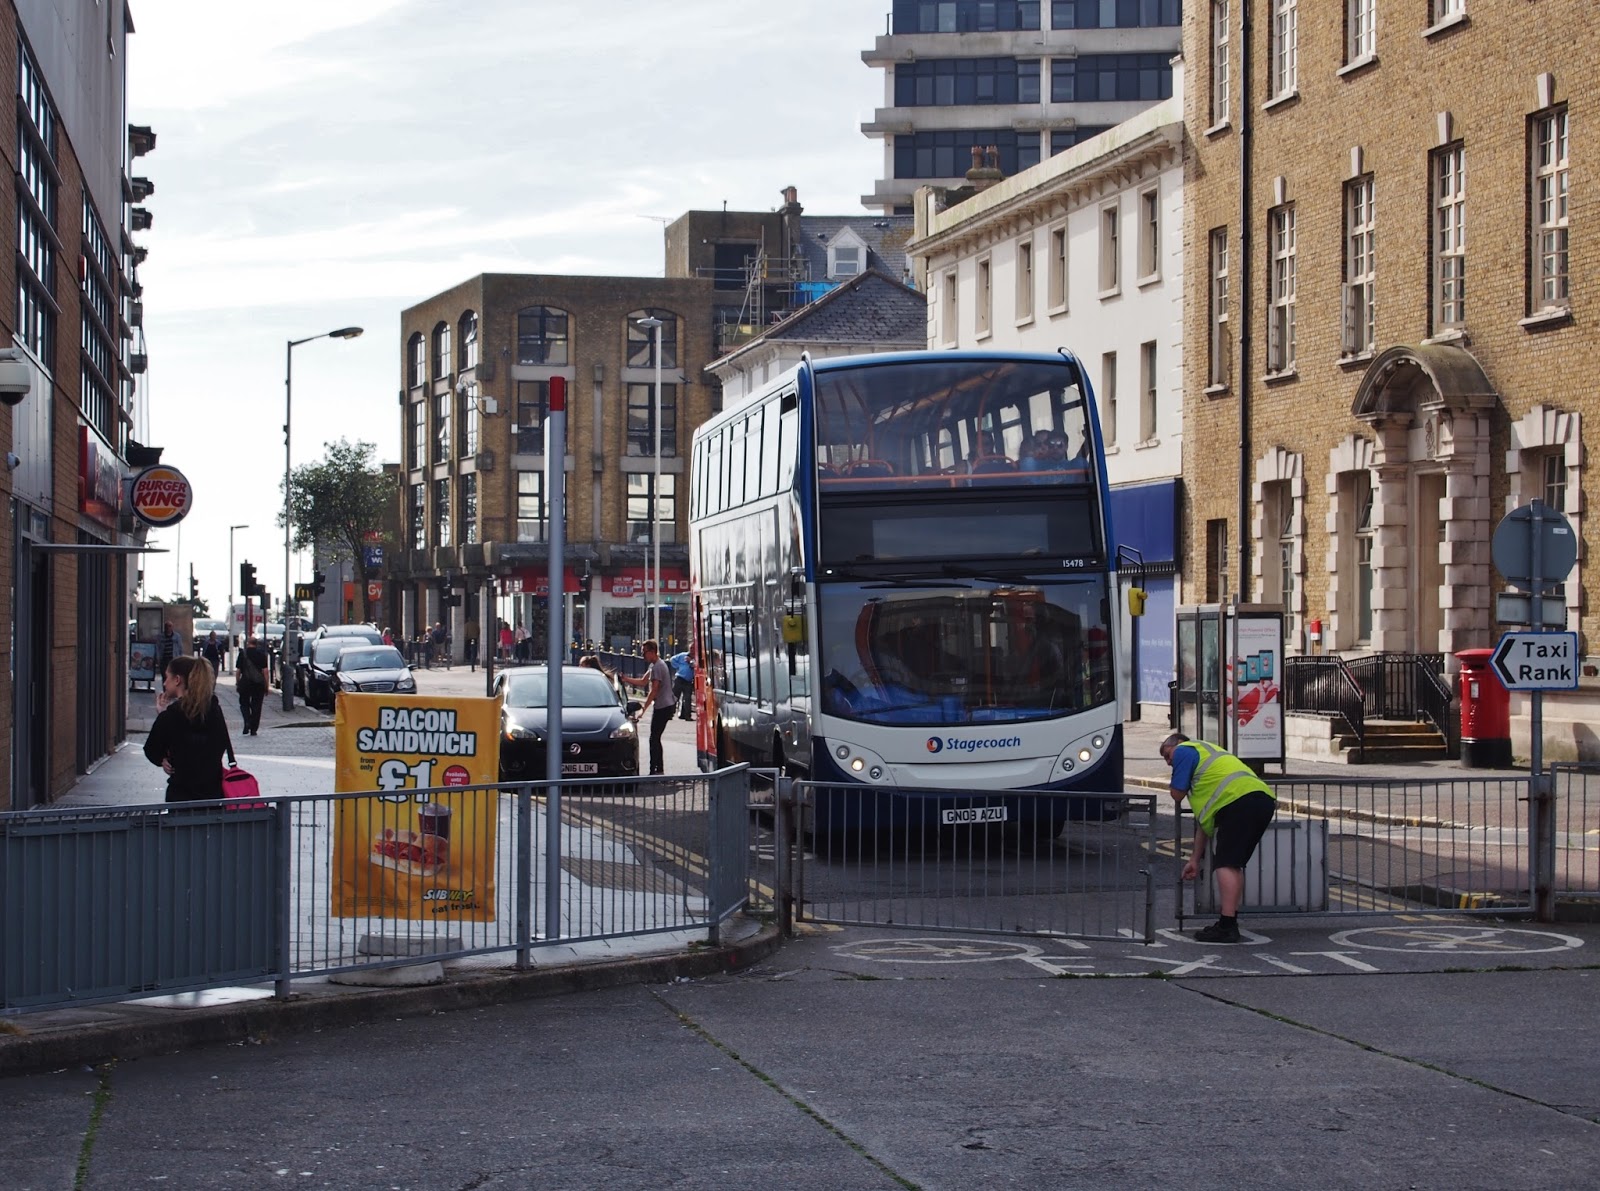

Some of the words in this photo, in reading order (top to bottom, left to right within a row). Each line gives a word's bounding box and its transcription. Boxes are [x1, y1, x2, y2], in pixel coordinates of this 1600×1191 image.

[137, 480, 187, 493] BURGER
[135, 491, 186, 508] KING
[1062, 559, 1084, 568] 15478
[1522, 641, 1568, 658] Taxi
[1519, 664, 1571, 681] Rank
[380, 708, 456, 732] BACON
[358, 730, 475, 755] SANDWICH
[946, 736, 1021, 753] Stagecoach
[360, 764, 374, 772] only
